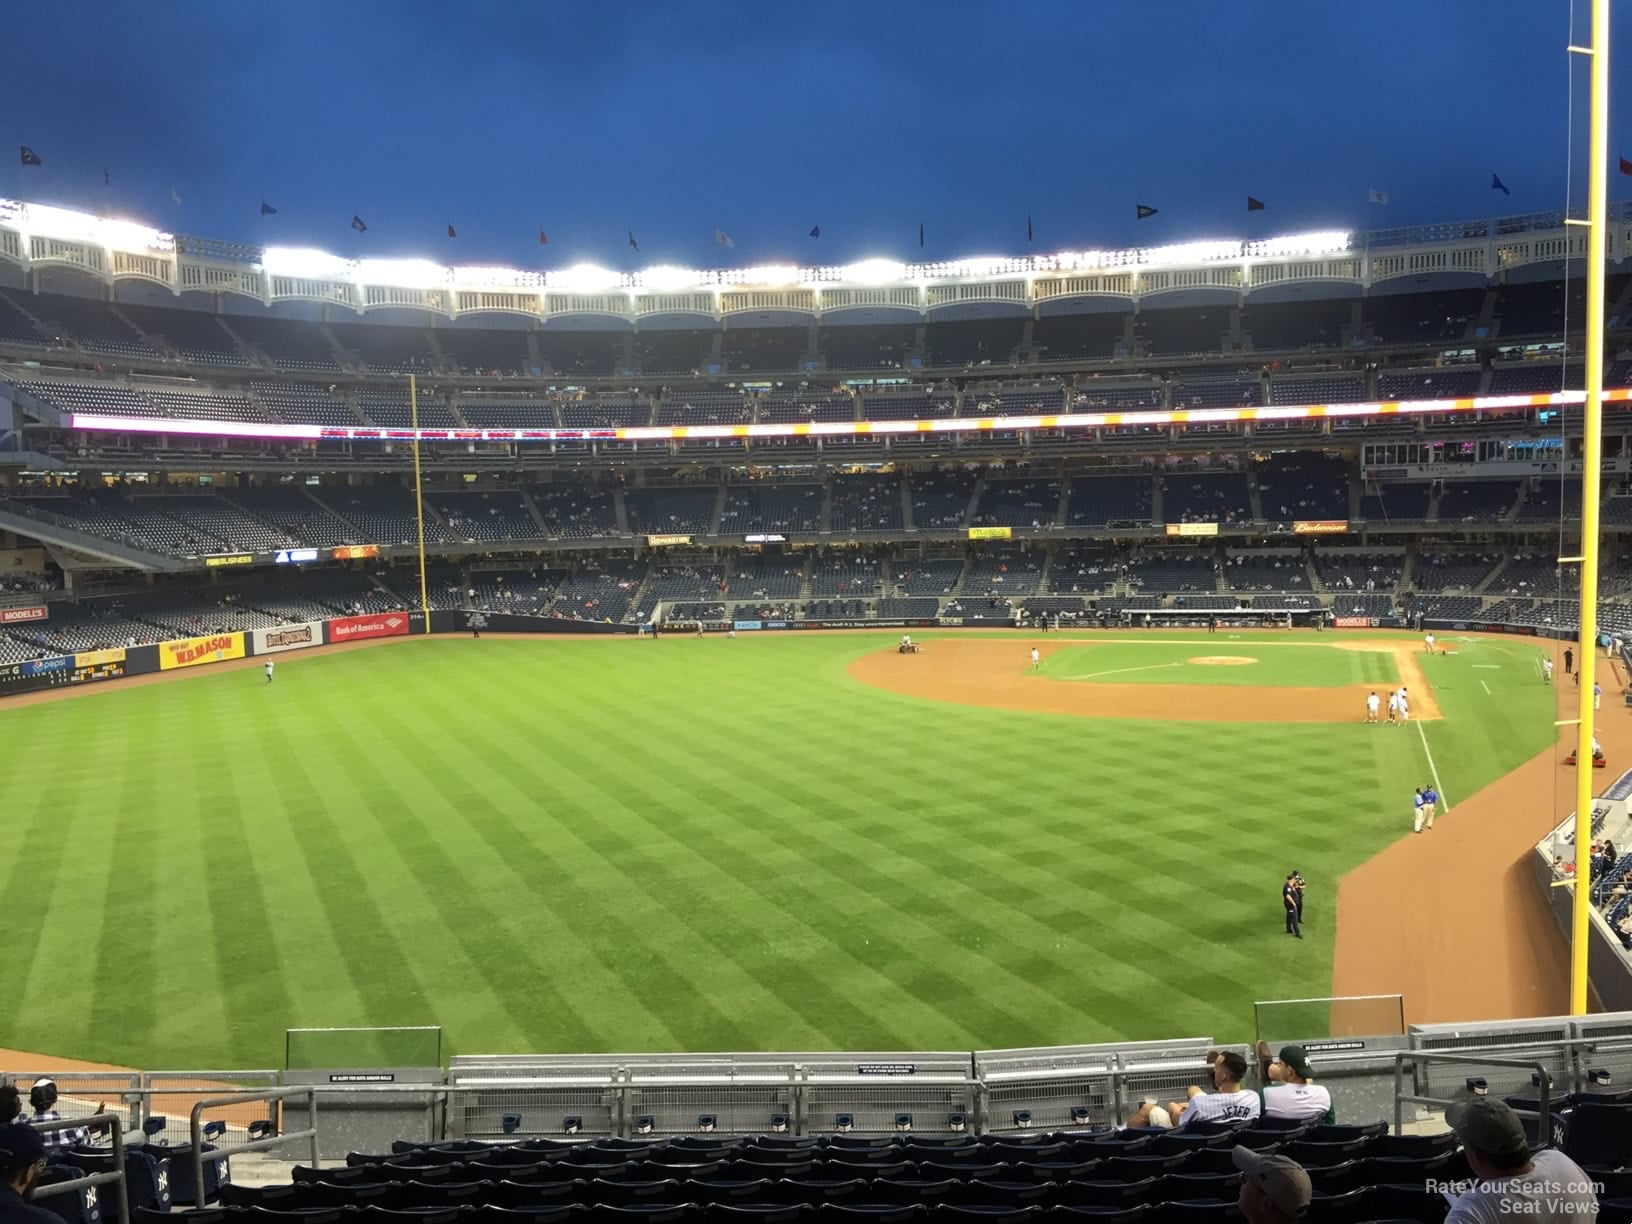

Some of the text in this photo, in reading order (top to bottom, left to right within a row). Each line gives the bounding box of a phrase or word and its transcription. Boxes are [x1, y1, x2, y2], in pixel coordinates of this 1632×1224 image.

[4, 609, 43, 620] MODELL'S
[336, 623, 385, 636] Bank of America
[44, 659, 66, 670] pepsi
[1222, 1105, 1250, 1119] JETER
